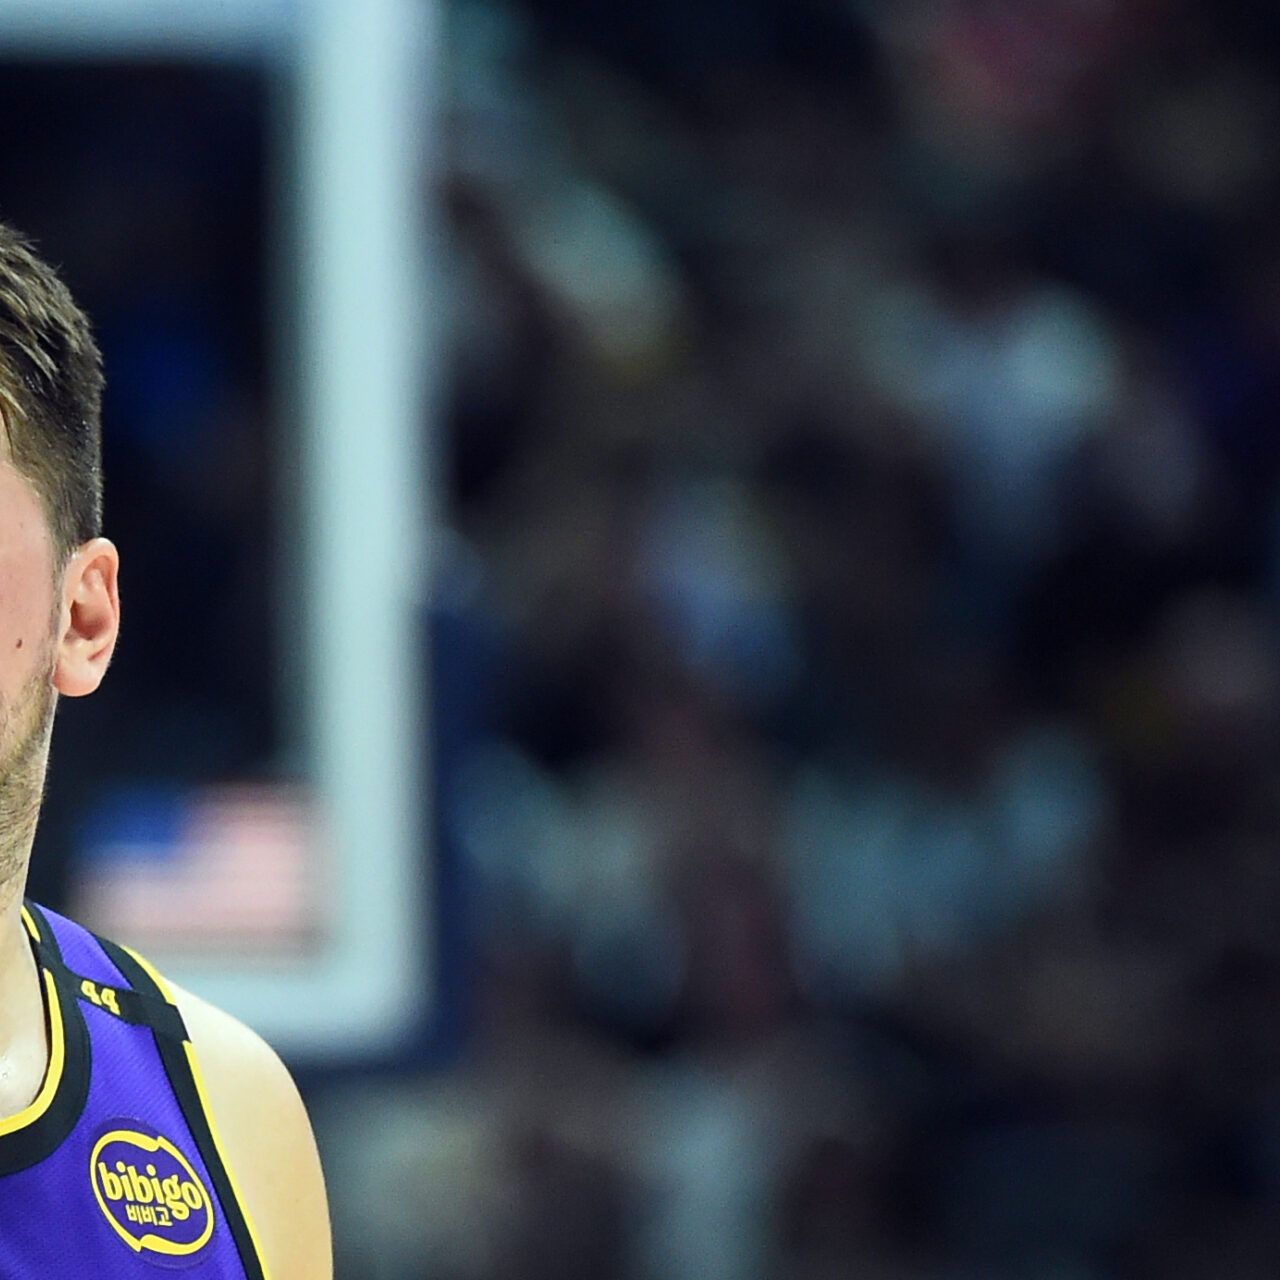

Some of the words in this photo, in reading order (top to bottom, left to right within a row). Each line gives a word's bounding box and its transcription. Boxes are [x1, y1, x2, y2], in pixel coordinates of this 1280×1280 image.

[80, 980, 122, 1015] 44
[98, 1161, 204, 1221] bibigo
[126, 1204, 173, 1227] 비비고
